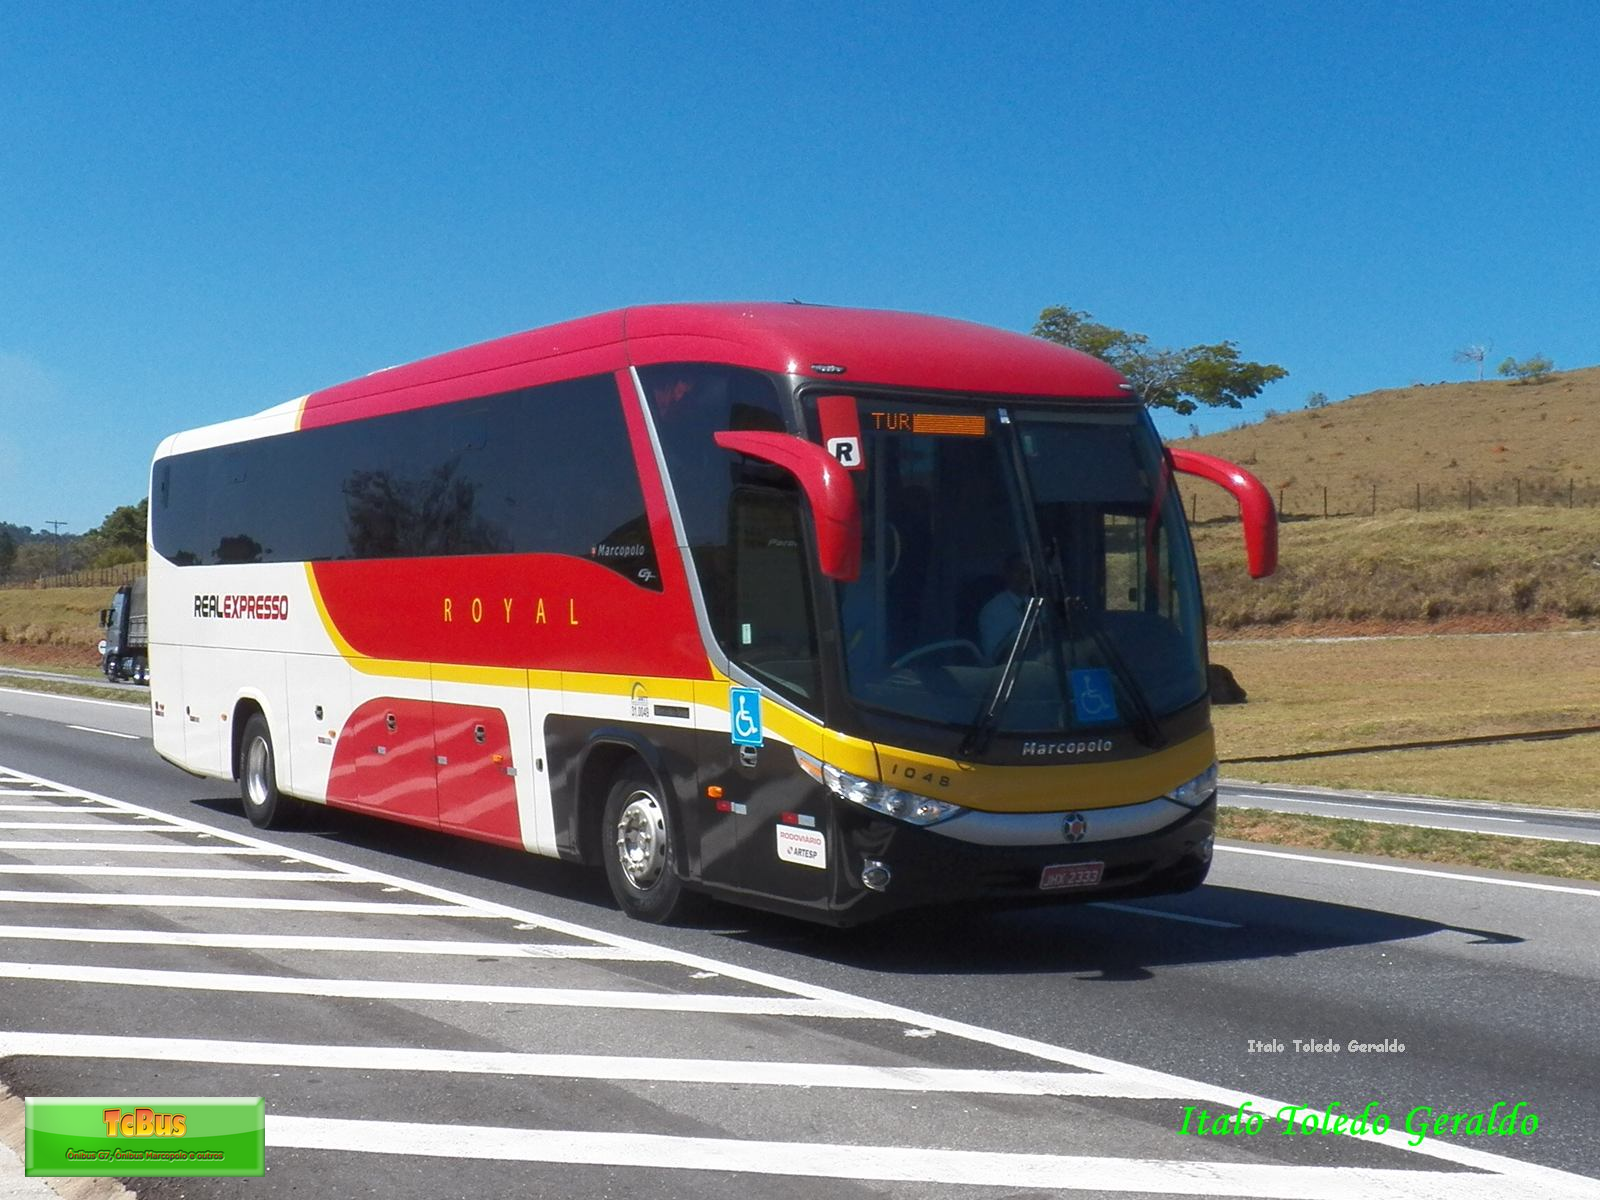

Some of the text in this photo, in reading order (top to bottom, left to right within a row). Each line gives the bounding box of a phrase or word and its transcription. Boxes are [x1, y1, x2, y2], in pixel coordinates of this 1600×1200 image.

[871, 412, 911, 431] TUR
[835, 442, 853, 462] R
[598, 544, 645, 557] Marcopolo
[444, 598, 579, 625] ROYAL
[1022, 739, 1113, 756] Marcopolo
[892, 763, 951, 787] 1048
[793, 847, 818, 859] ARTESP
[1067, 870, 1099, 884] 2333
